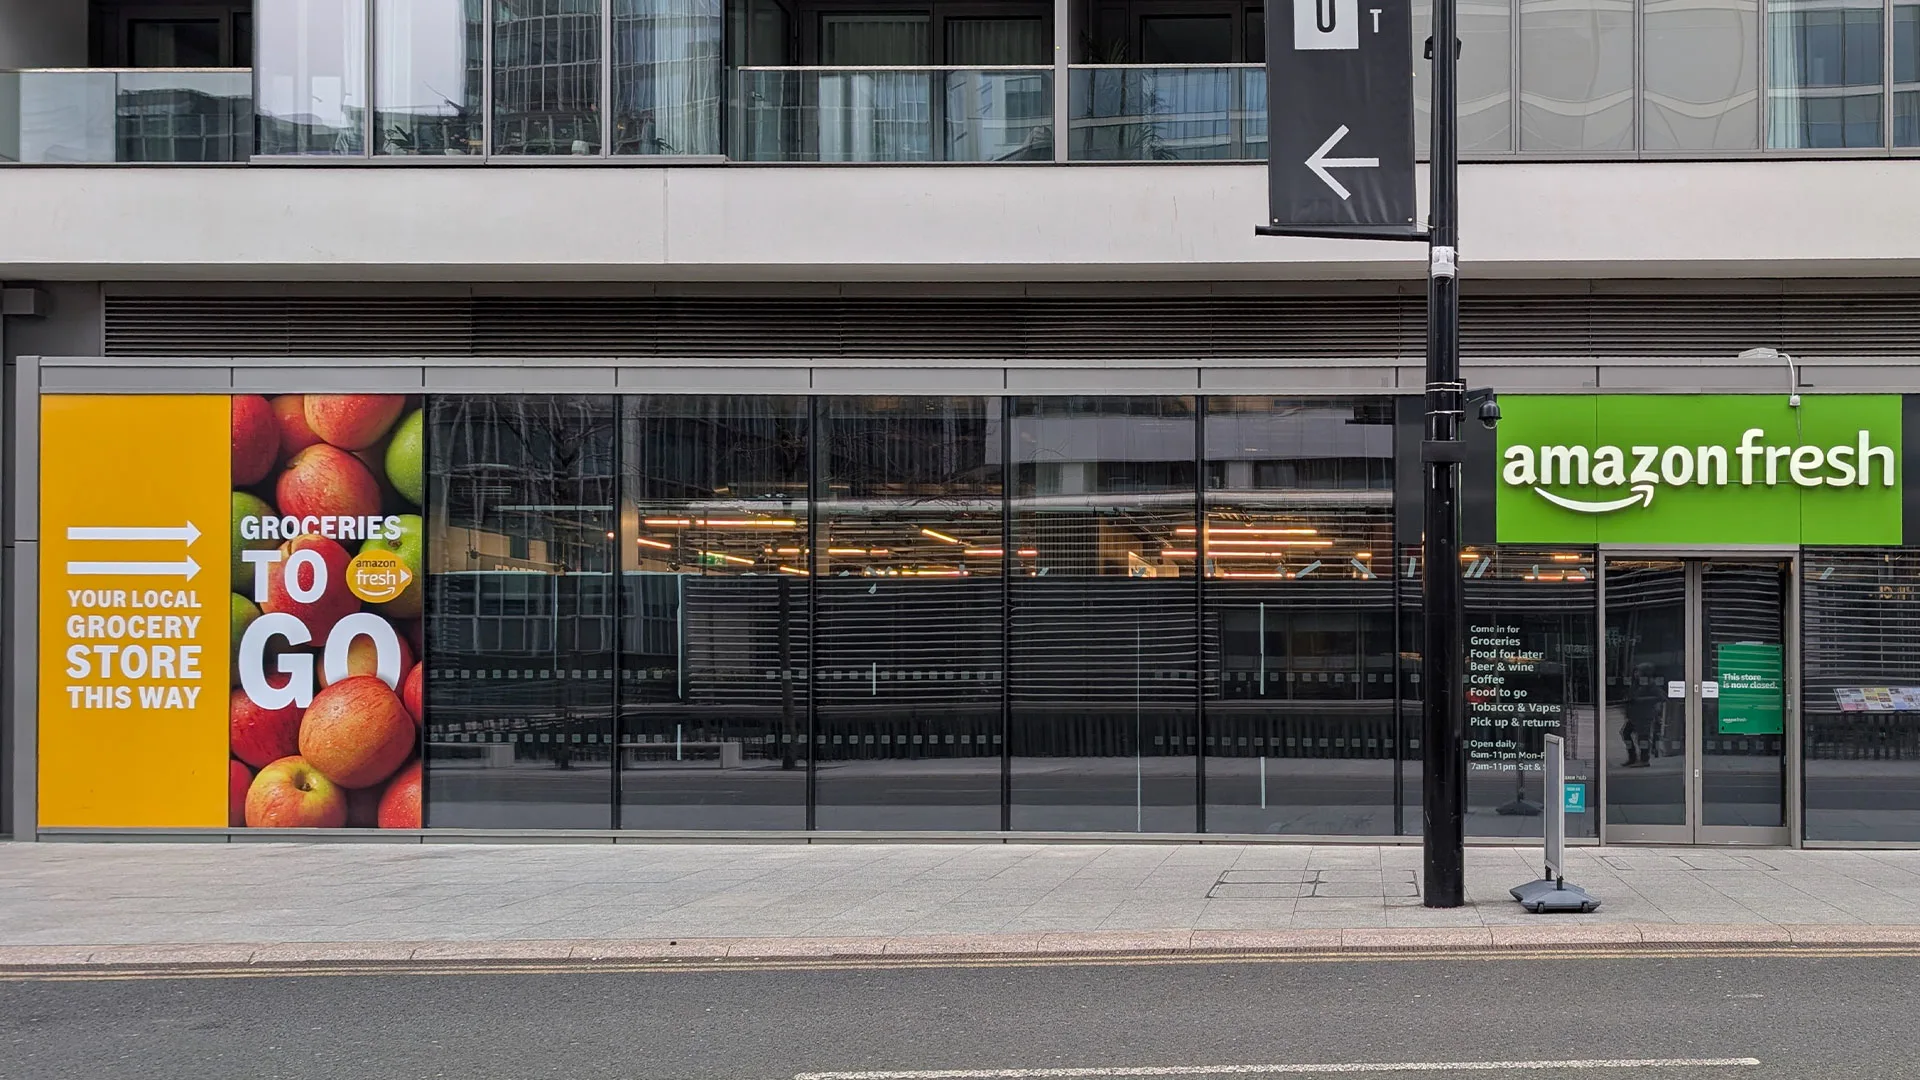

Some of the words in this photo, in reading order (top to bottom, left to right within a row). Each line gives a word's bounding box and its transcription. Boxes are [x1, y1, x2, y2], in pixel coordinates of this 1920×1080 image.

[1369, 9, 1382, 33] T
[1503, 444, 1728, 486] amazon
[1735, 428, 1894, 487] fresh
[240, 515, 402, 540] GROCERIES
[355, 560, 396, 568] amazon
[242, 549, 328, 604] TO
[355, 569, 396, 586] fresh
[66, 589, 127, 608] YOUR
[131, 589, 202, 608] LOCAL
[66, 614, 202, 639] GROCERY
[1470, 625, 1495, 633] Come
[1496, 625, 1505, 633] in
[1506, 625, 1520, 633] for
[1470, 636, 1521, 646] Groceries
[1470, 649, 1497, 659] Food
[1499, 649, 1515, 659] for
[1518, 649, 1544, 659] later
[66, 644, 202, 679] STORE
[238, 612, 401, 711] GO
[1470, 662, 1494, 671] Beer
[1496, 662, 1505, 671] &
[1508, 662, 1534, 672] wine
[1470, 674, 1505, 684] Coffee
[1722, 673, 1740, 681] This
[66, 686, 132, 709] THIS
[138, 686, 202, 709] WAY
[1470, 687, 1496, 697] Food
[1499, 688, 1511, 697] to
[1513, 689, 1528, 699] go
[1471, 702, 1515, 712] Tobacco
[1517, 702, 1526, 712] &
[1529, 703, 1561, 714] Vapes
[1470, 717, 1492, 726] Pick
[1494, 719, 1509, 729] up
[1511, 717, 1520, 727] &
[1522, 718, 1561, 727] returns
[1470, 740, 1494, 748] Open
[1495, 740, 1517, 749] daily
[1470, 751, 1517, 760] 6am-11pm
[1518, 751, 1545, 759] Mon-F
[1470, 762, 1517, 772] 7am-11pm
[1518, 763, 1533, 771] Sat
[1534, 763, 1542, 771] &
